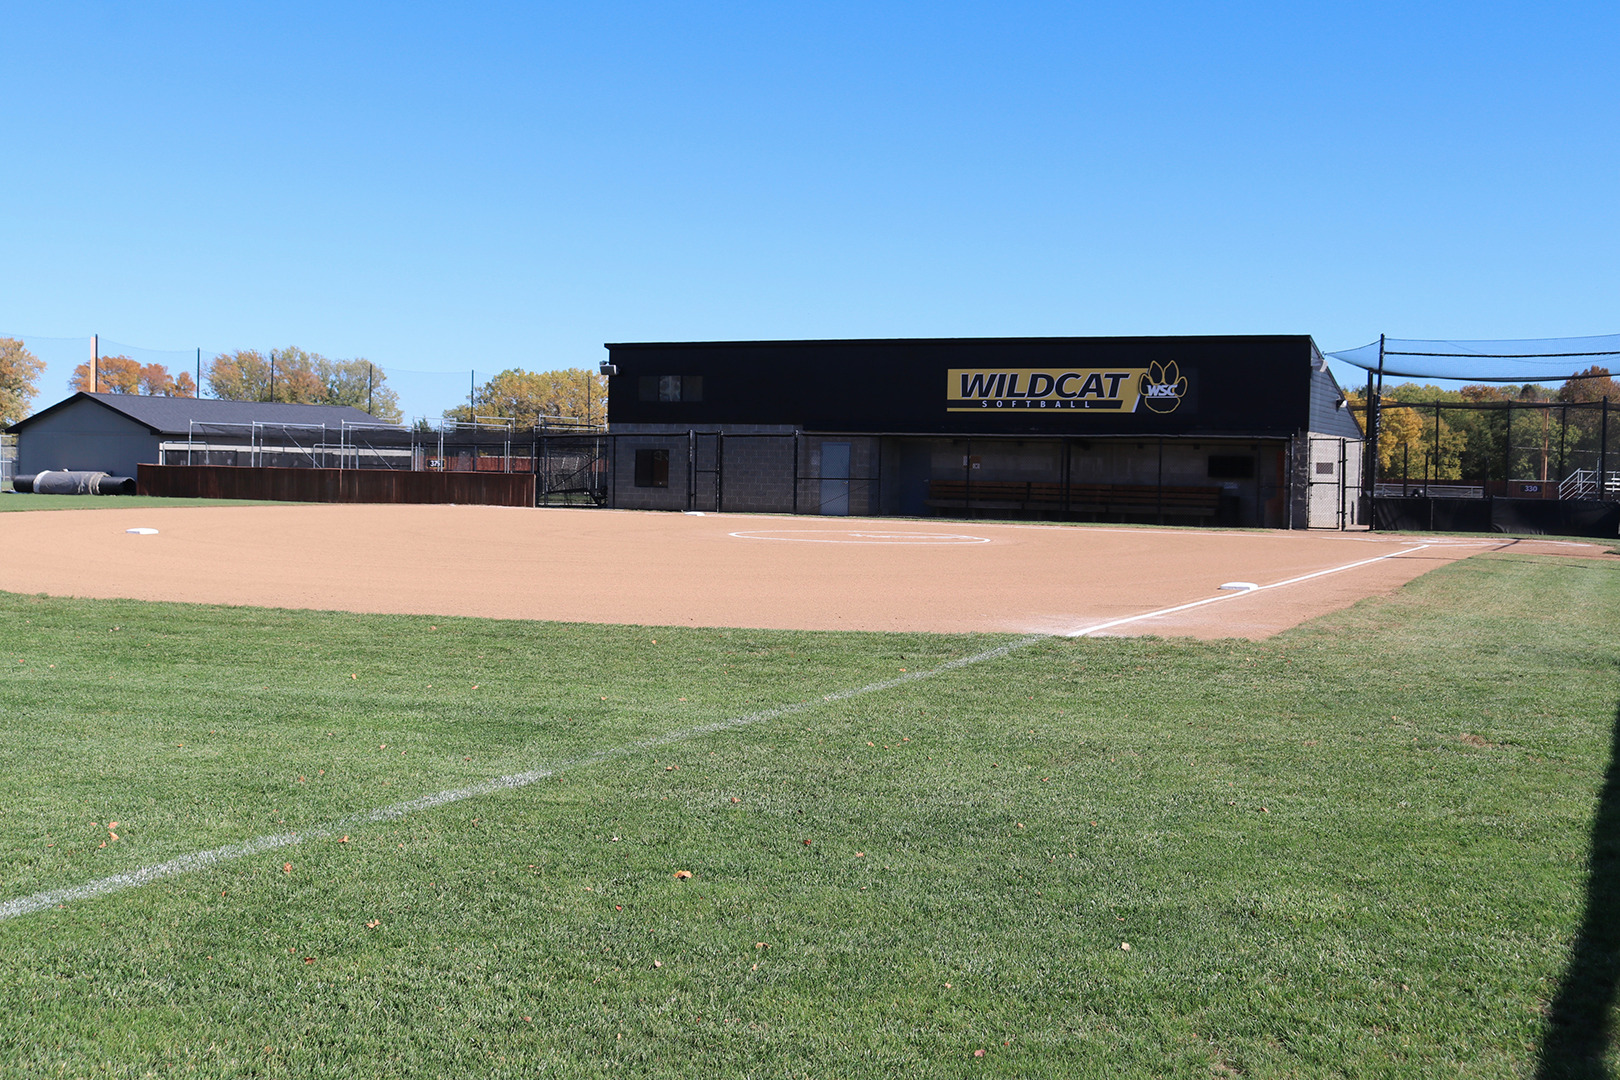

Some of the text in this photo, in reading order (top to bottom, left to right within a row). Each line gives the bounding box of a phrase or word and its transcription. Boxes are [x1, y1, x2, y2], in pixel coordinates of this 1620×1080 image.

[960, 372, 1131, 399] WILDCAT
[1146, 384, 1178, 396] WSC
[982, 400, 1090, 408] SOFTBALL
